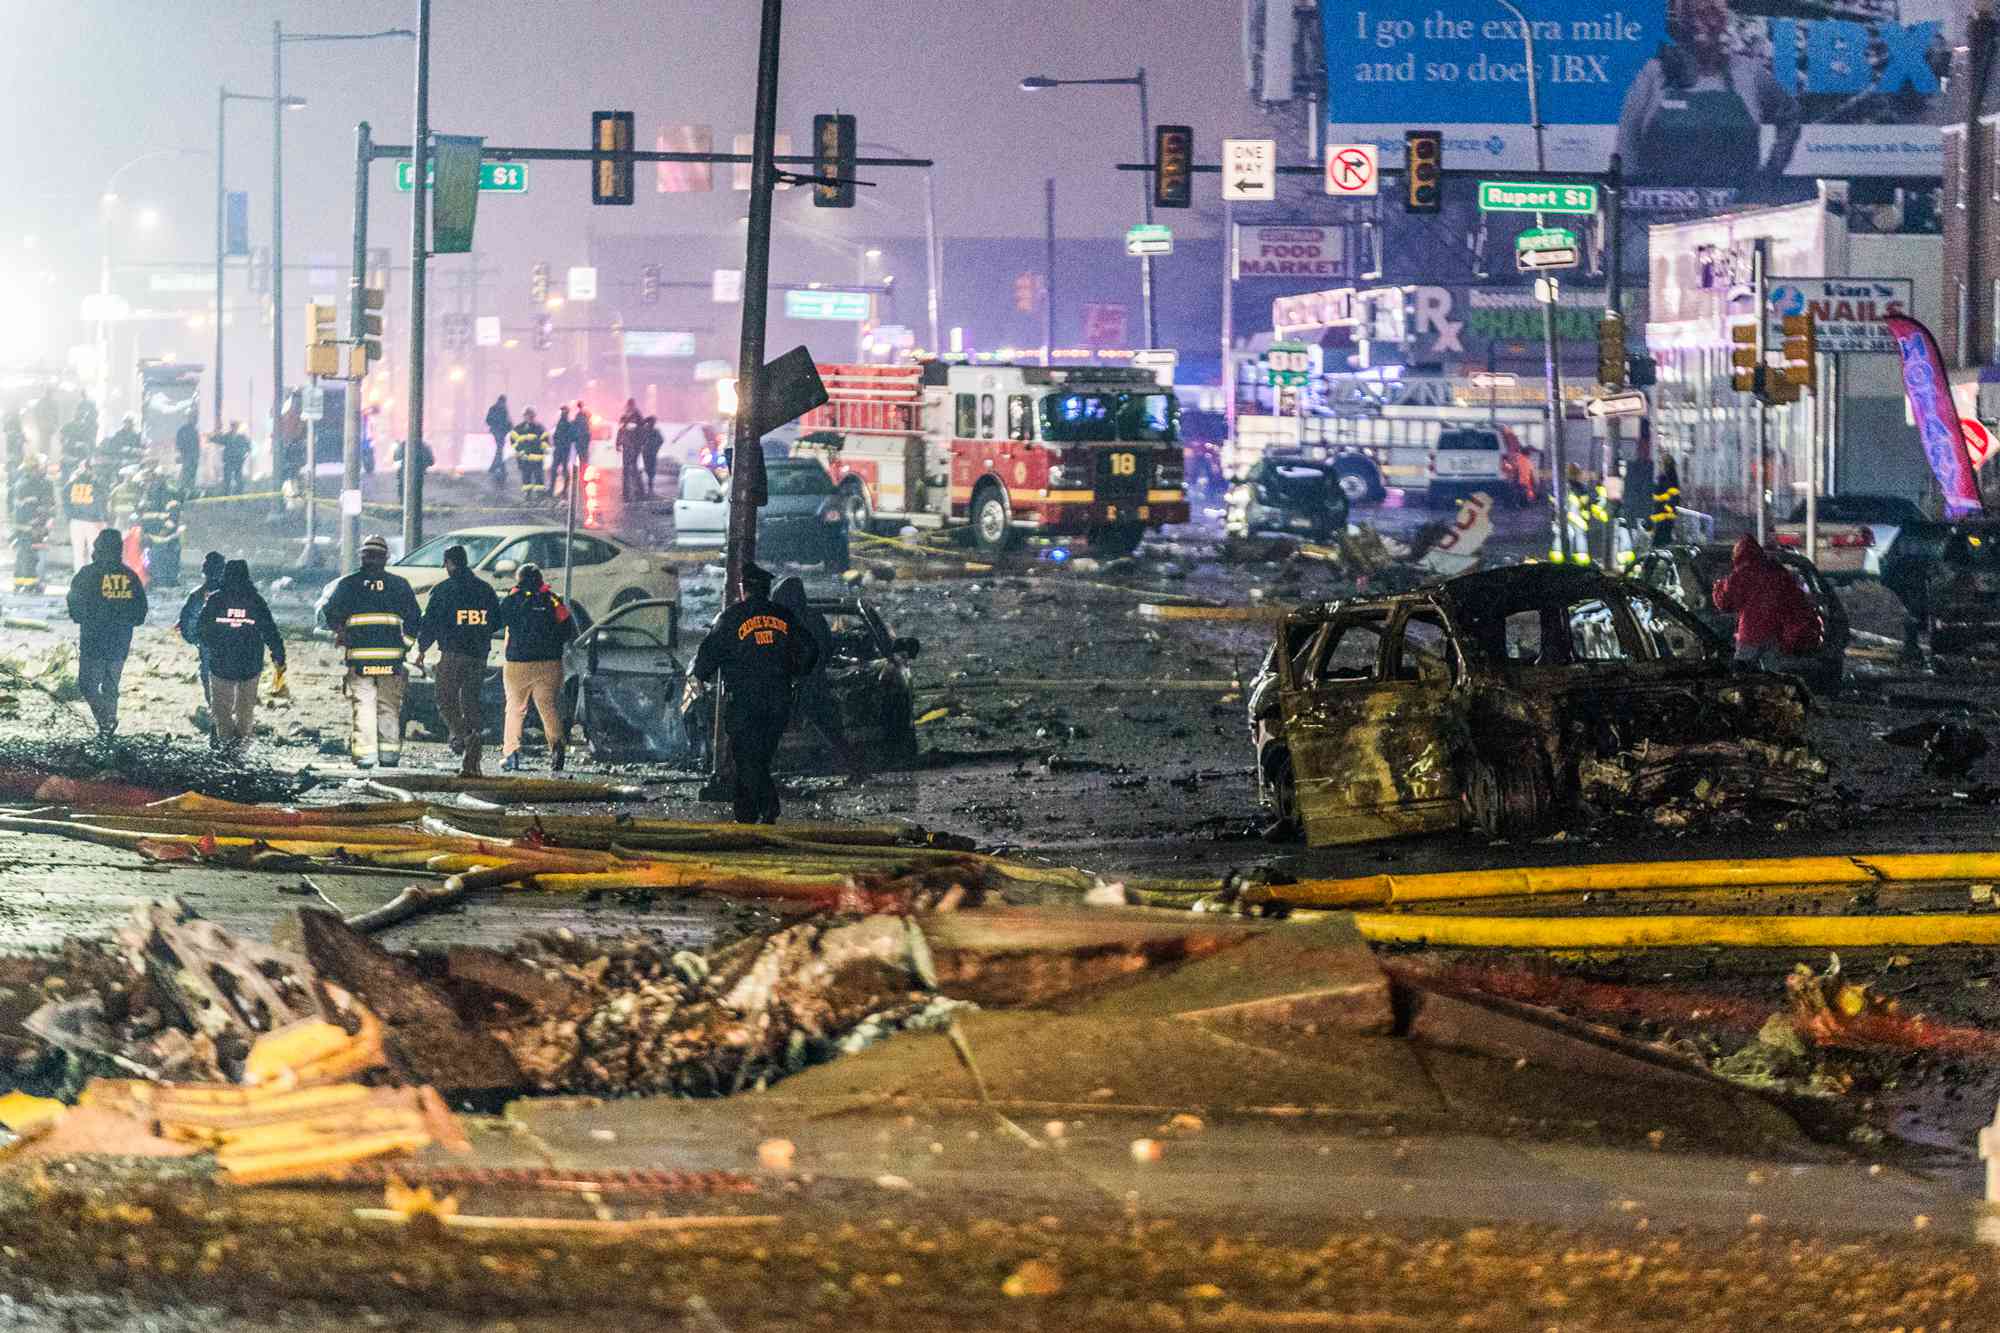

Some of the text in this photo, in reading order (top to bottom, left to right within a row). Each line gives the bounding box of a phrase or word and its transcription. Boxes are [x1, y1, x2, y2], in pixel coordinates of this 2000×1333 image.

[1356, 11, 1367, 39] I
[1376, 19, 1415, 48] go
[1424, 10, 1474, 40] the
[1571, 12, 1643, 41] mile
[1355, 53, 1415, 81] and
[1425, 62, 1459, 82] so
[1550, 54, 1609, 83] IBX
[1235, 146, 1264, 159] ONE
[493, 167, 518, 185] St
[1234, 163, 1263, 173] WAY
[1488, 188, 1587, 206] Rupert St
[1261, 244, 1322, 258] FOOD
[1240, 260, 1341, 274] MARKET
[1809, 300, 1905, 321] NAILS
[1110, 453, 1136, 476] 18
[102, 574, 129, 591] ATF
[227, 608, 246, 618] FBI
[456, 609, 488, 625] FBI
[738, 616, 788, 640] CRIME SCENE
[755, 631, 774, 645] UNIT
